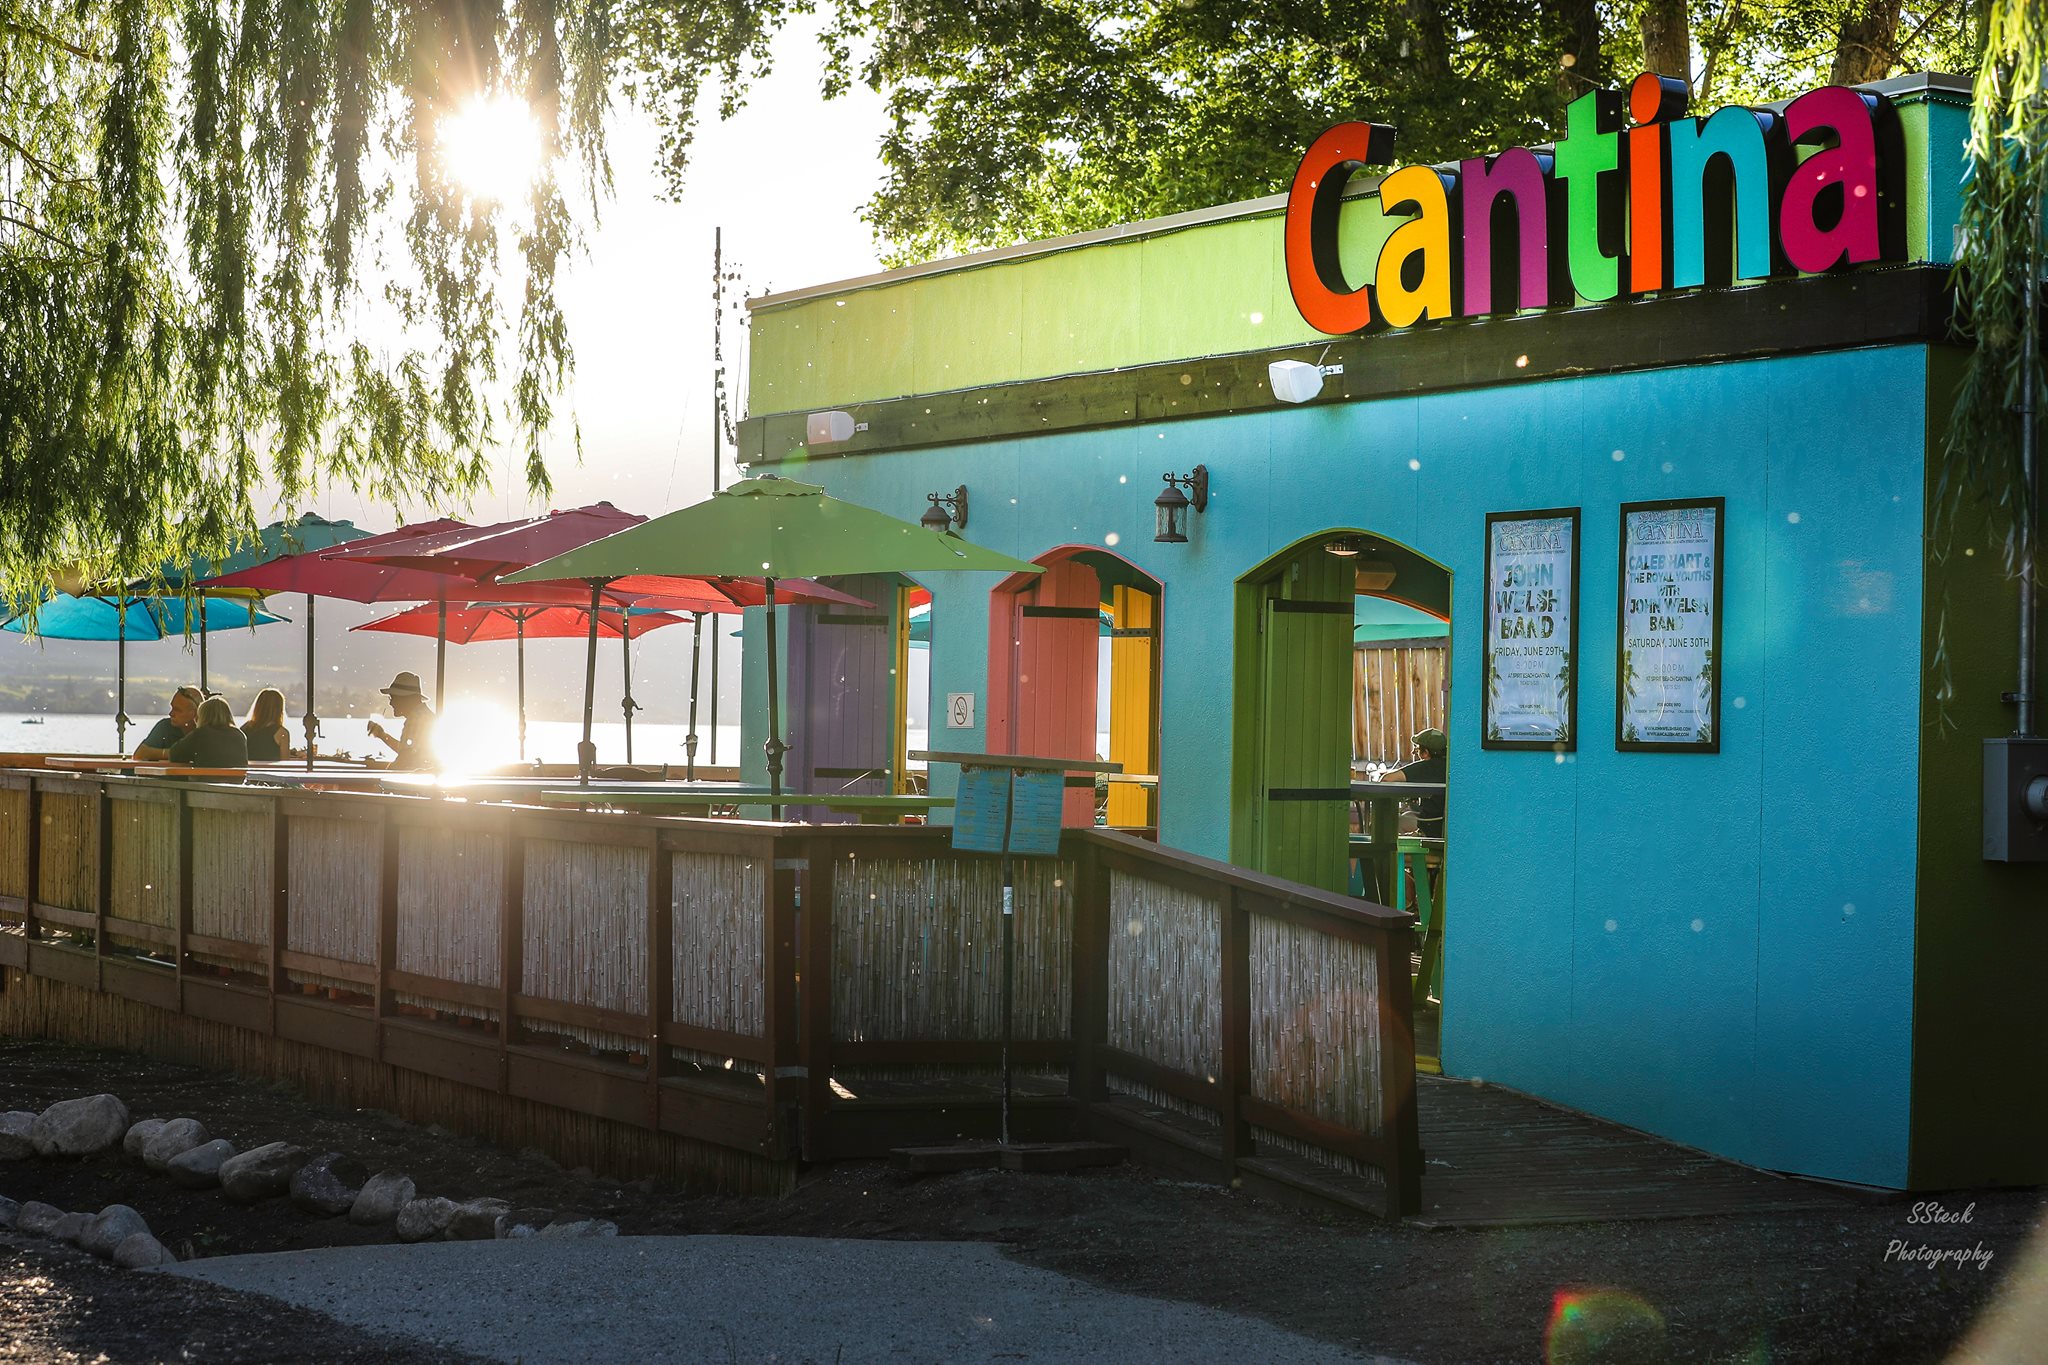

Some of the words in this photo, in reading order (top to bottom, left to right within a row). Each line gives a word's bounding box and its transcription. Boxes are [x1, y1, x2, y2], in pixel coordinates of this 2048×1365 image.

[1285, 71, 1882, 336] Cantina
[1637, 521, 1703, 540] CANTINA
[1500, 533, 1562, 551] CANTINA
[1629, 554, 1666, 570] CALEB
[1668, 553, 1702, 569] HART
[1704, 556, 1711, 568] &
[1503, 563, 1553, 587] JOHN
[1630, 572, 1645, 583] THE
[1647, 572, 1674, 583] ROYAL
[1676, 571, 1711, 582] YOUTHS
[1657, 585, 1680, 596] WITH
[1495, 589, 1562, 613] WELSH
[1630, 598, 1660, 614] JOHN
[1663, 597, 1709, 613] WELSH
[1501, 615, 1554, 639] BAND
[1650, 616, 1684, 631] BAND
[1629, 638, 1667, 648] SATURDAY,
[1669, 638, 1688, 647] JUNE
[1690, 637, 1709, 647] 30TH
[1495, 647, 1522, 657] FRIDAY,
[1523, 647, 1543, 656] JUNE
[1545, 646, 1565, 656] 29TH
